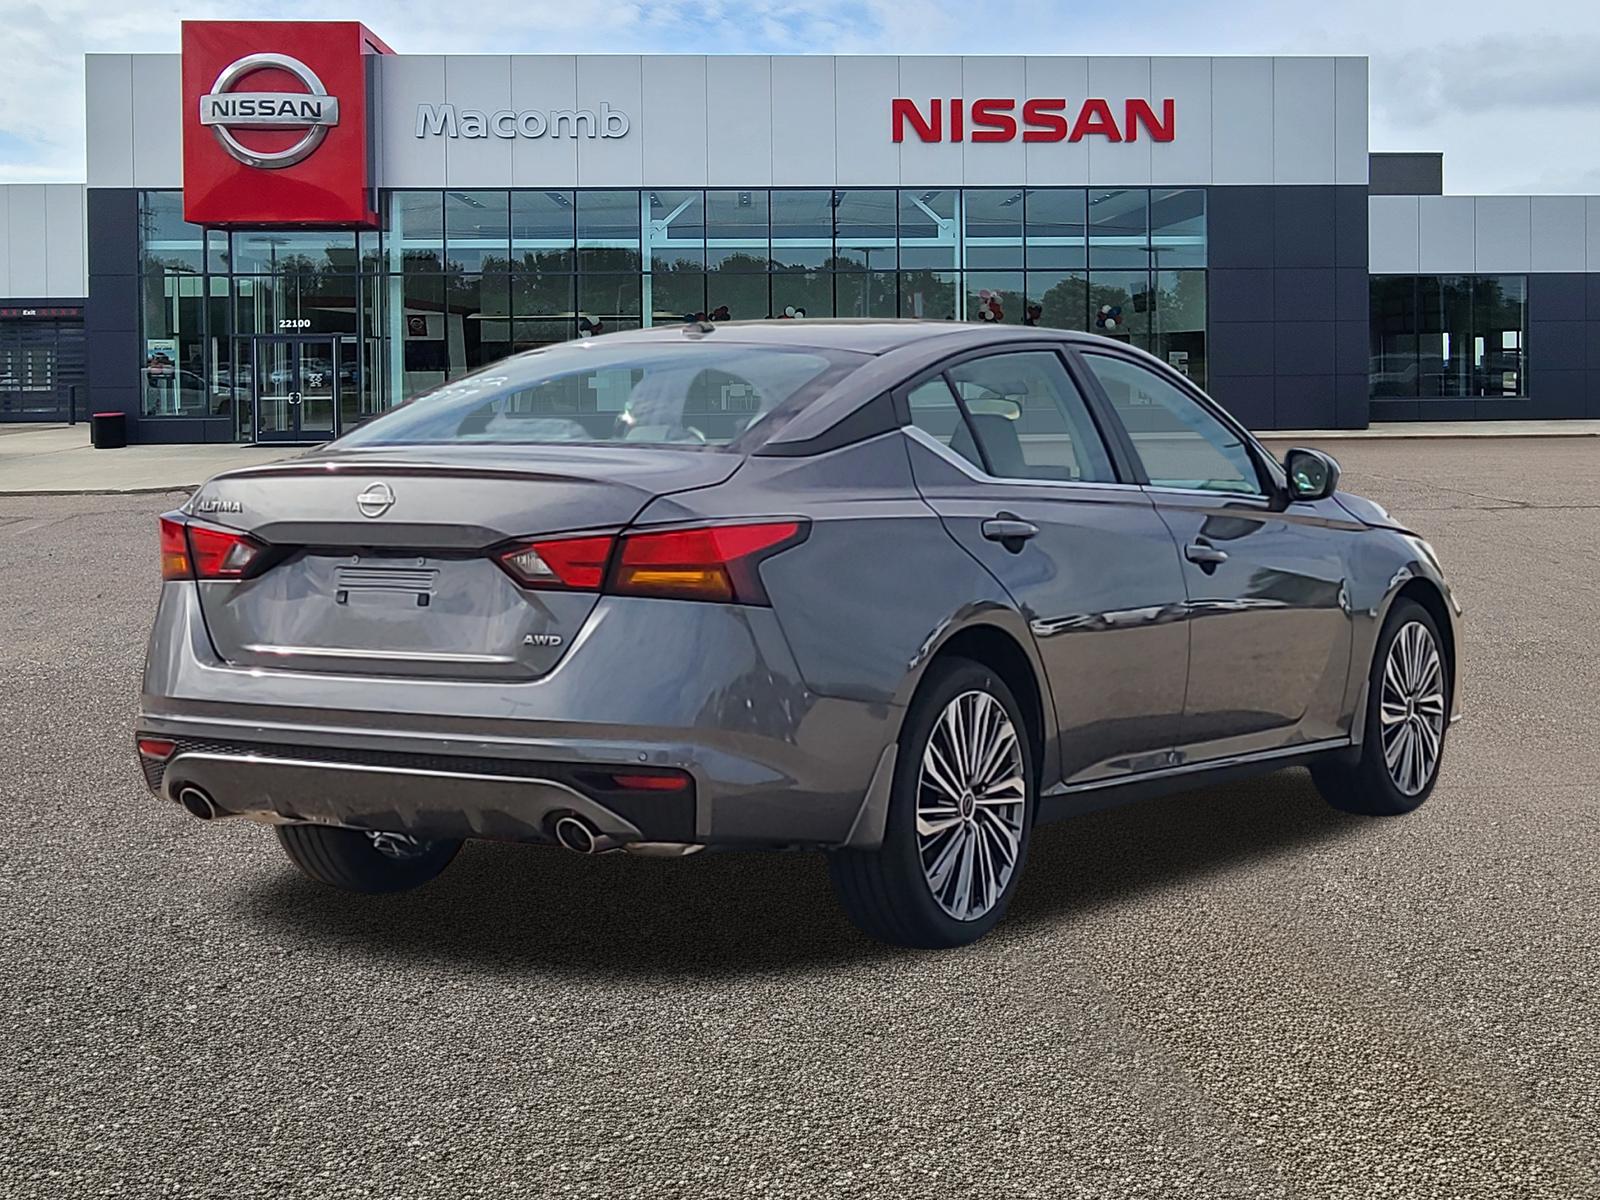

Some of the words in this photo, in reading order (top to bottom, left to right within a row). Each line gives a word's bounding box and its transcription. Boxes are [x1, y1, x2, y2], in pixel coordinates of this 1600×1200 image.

[212, 100, 321, 118] NISSAN
[415, 103, 630, 139] Macomb
[892, 98, 1175, 143] NISSAN
[279, 319, 311, 328] 22100
[198, 500, 243, 513] ALTIMA
[522, 633, 563, 647] AWD
